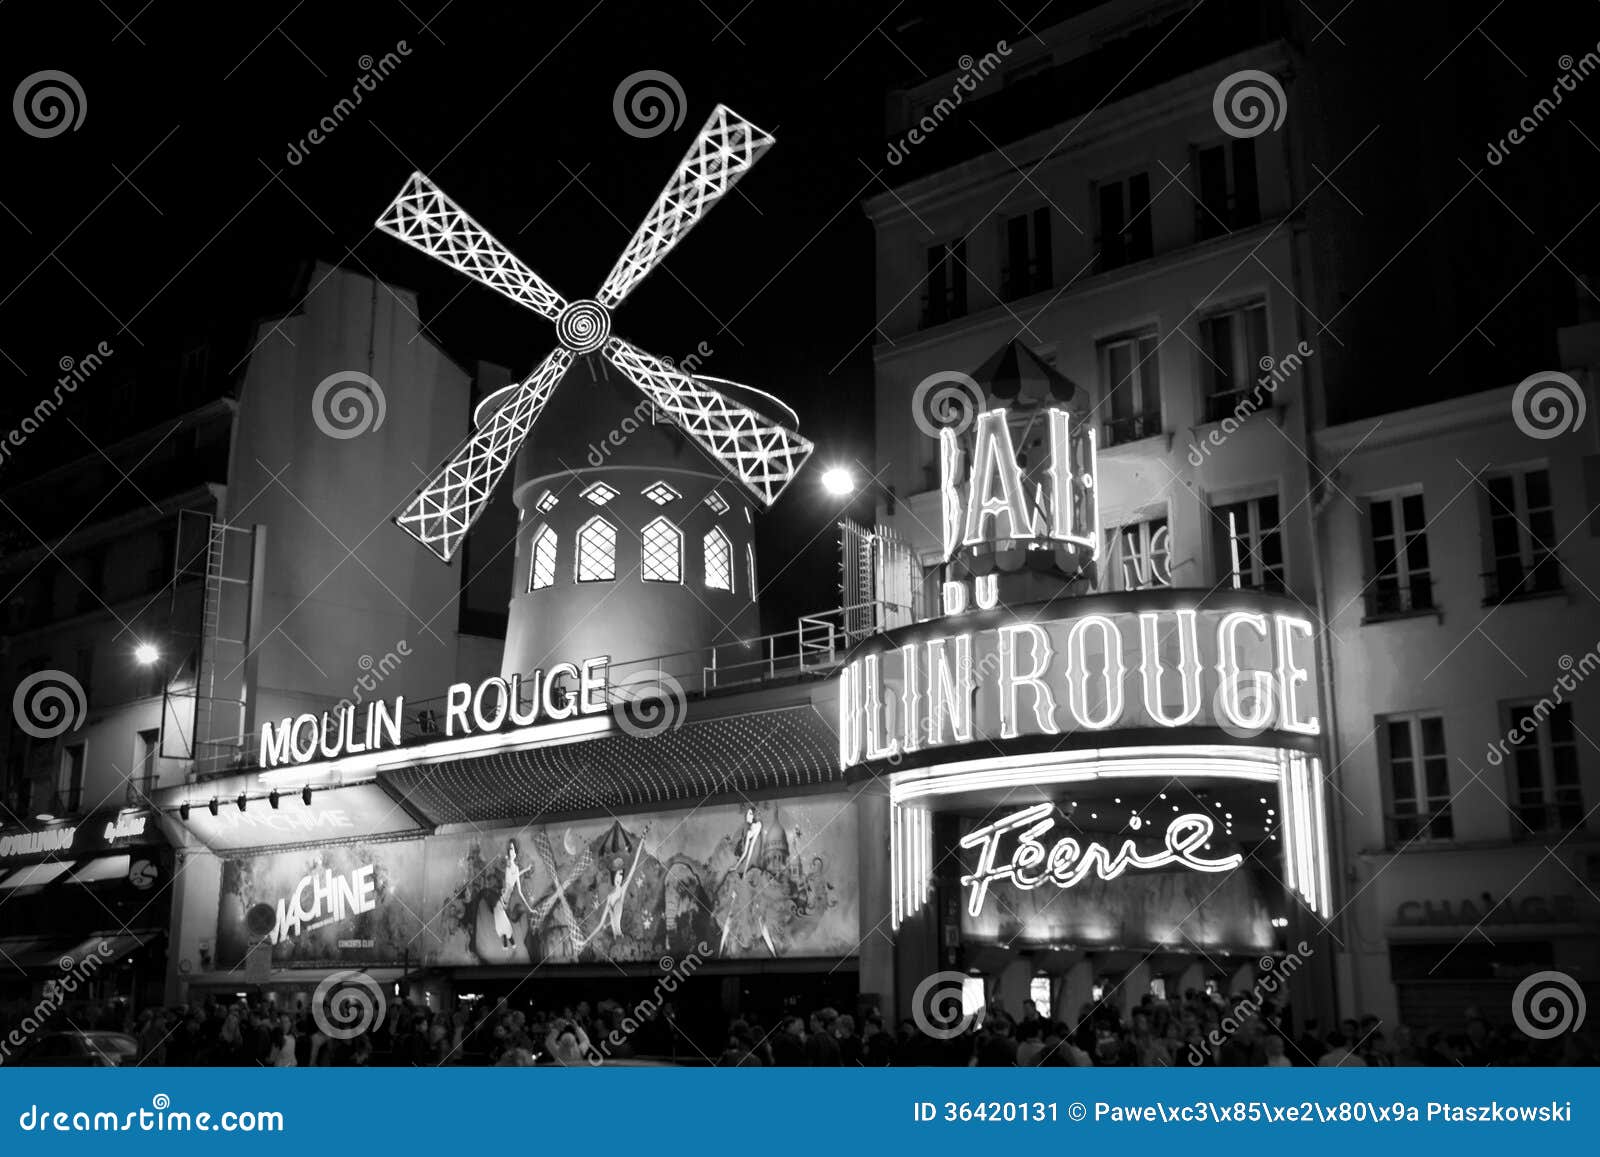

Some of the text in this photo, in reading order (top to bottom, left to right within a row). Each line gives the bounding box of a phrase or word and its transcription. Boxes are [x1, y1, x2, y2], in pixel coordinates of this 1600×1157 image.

[943, 574, 998, 616] DU
[258, 655, 610, 768] MOULIN ROUGE
[839, 609, 1321, 772] ULIN ROUGE
